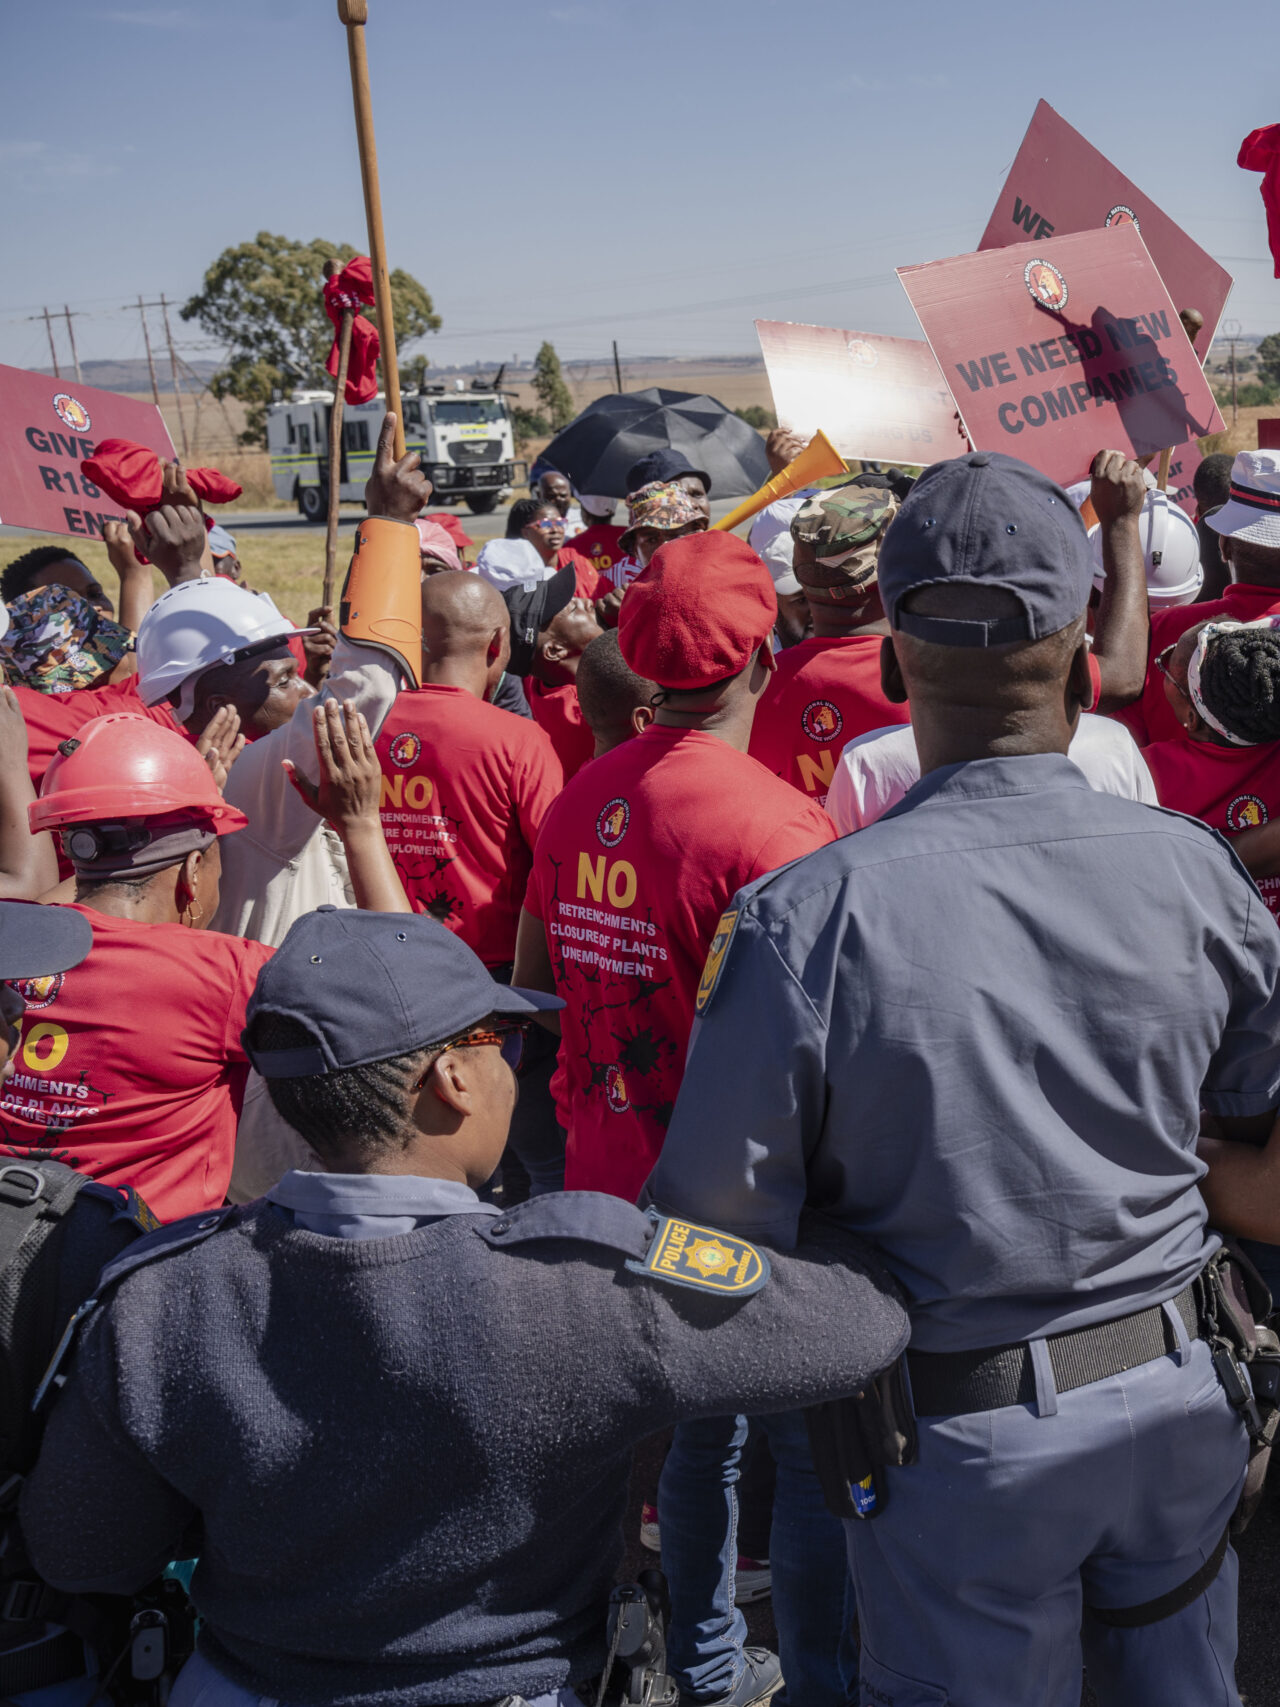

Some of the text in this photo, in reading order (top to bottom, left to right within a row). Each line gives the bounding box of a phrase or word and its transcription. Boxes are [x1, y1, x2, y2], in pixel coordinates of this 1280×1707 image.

[956, 310, 1172, 392] WE NEED NEW
[998, 356, 1179, 434] COMPANIES
[379, 774, 433, 810] NO
[576, 851, 637, 909] NO
[559, 902, 656, 937] RETRENCHMENTS
[550, 922, 668, 961] CLOSURE OF PLANTS
[562, 945, 654, 978] UNEMPOYMENT
[660, 1224, 690, 1271] POLICE
